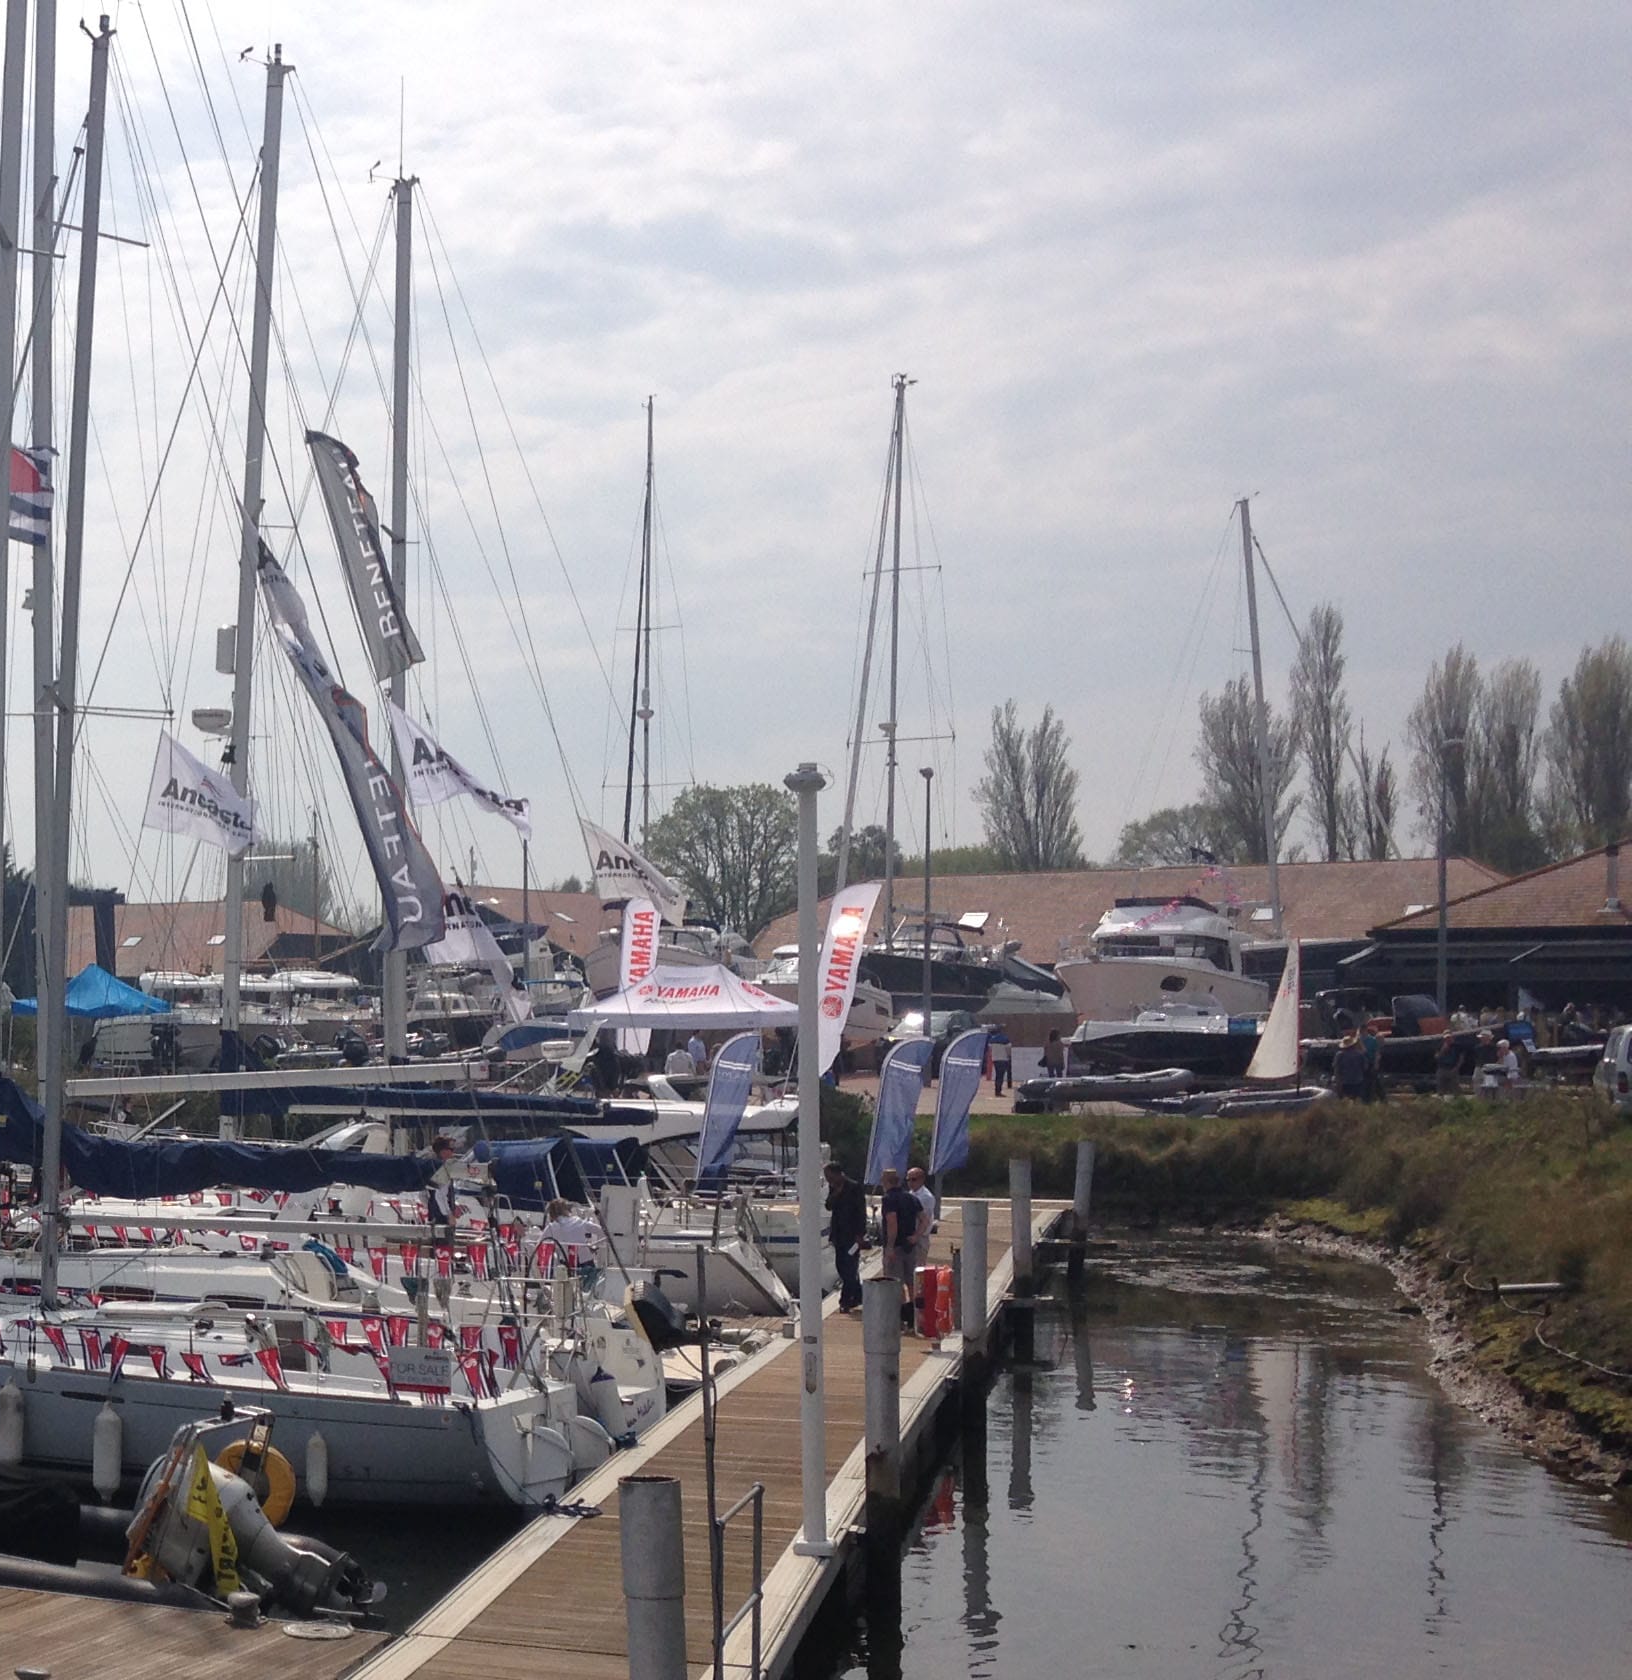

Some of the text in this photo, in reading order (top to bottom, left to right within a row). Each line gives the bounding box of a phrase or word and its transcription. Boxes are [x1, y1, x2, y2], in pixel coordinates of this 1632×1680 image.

[825, 907, 865, 992] YAMAA
[657, 984, 720, 999] YAMAHA
[418, 1364, 449, 1377] SALE
